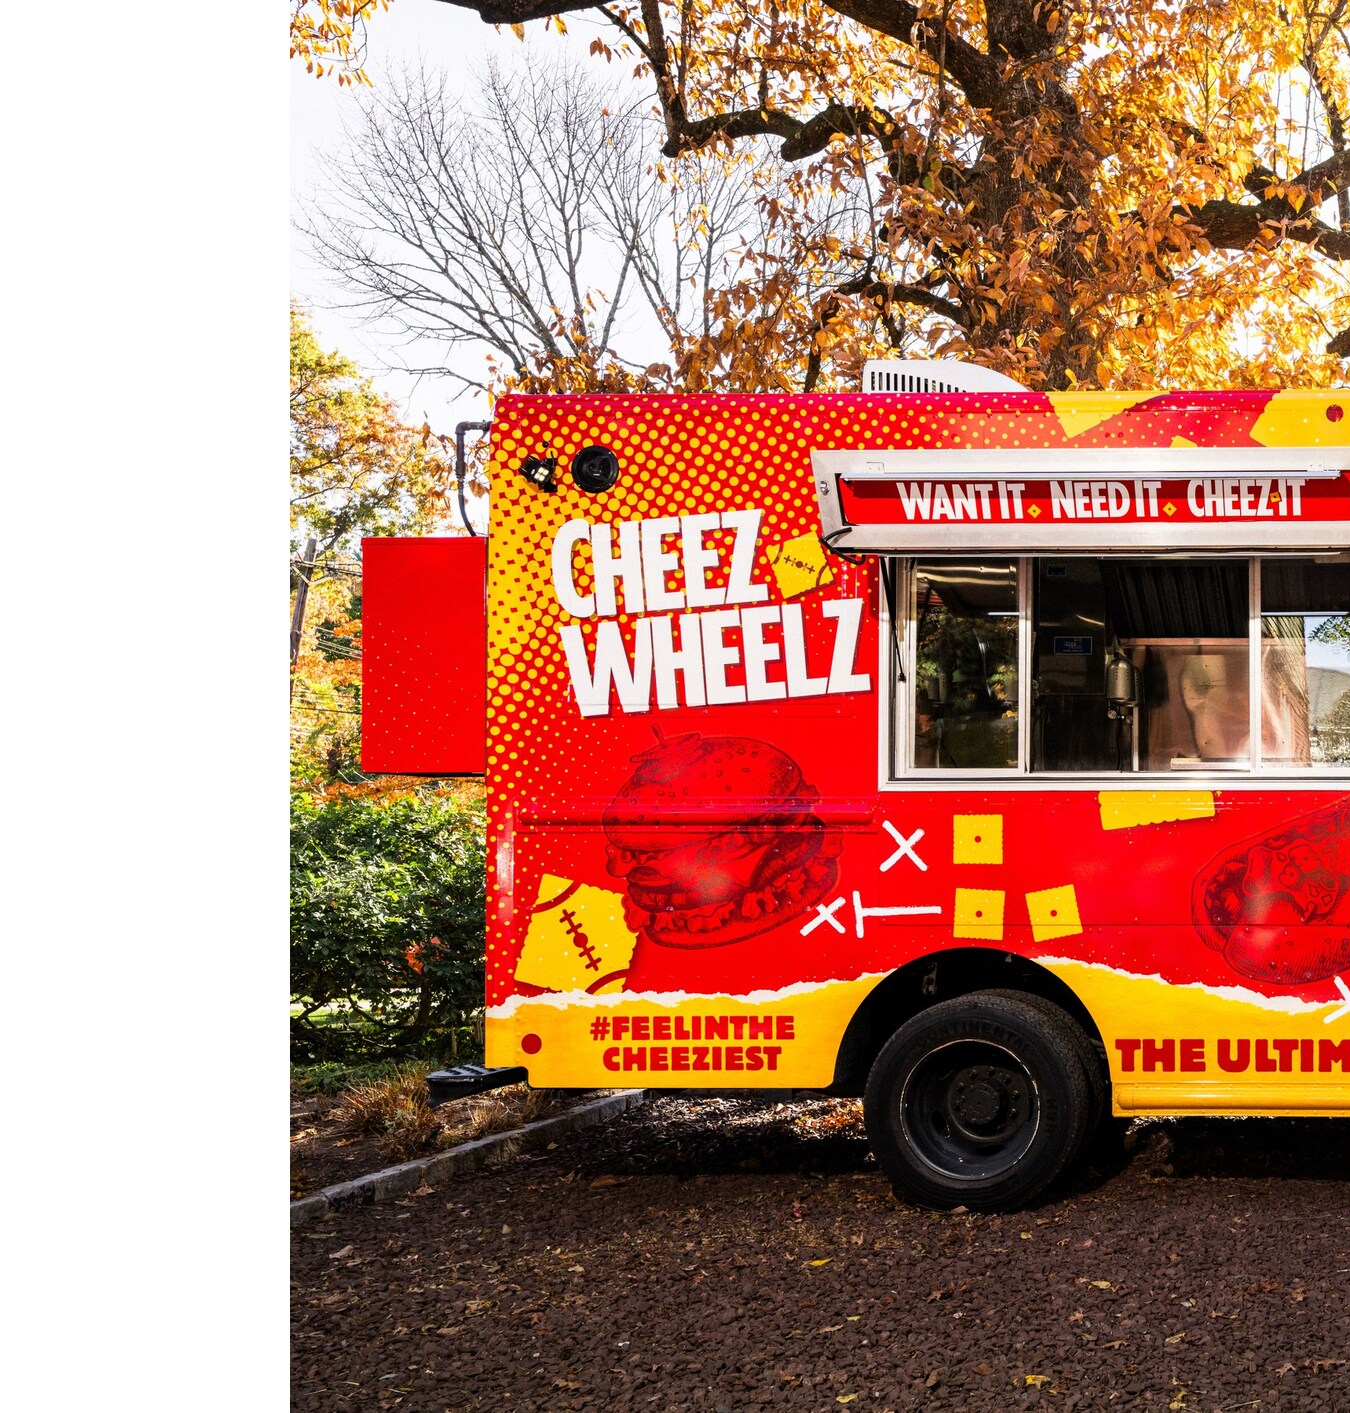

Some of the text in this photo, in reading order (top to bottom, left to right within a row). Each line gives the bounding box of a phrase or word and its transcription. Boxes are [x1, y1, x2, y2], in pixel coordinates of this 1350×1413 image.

[896, 482, 993, 520] WANT
[997, 481, 1025, 519] IT
[1050, 480, 1130, 519] NEED
[1134, 480, 1162, 518] IT
[552, 509, 769, 618] CHEEZ
[558, 598, 872, 717] WHEELZ
[590, 1016, 795, 1041] #FEELINTHE
[603, 1046, 782, 1071] CHEEZIEST
[1115, 1038, 1205, 1073] THE
